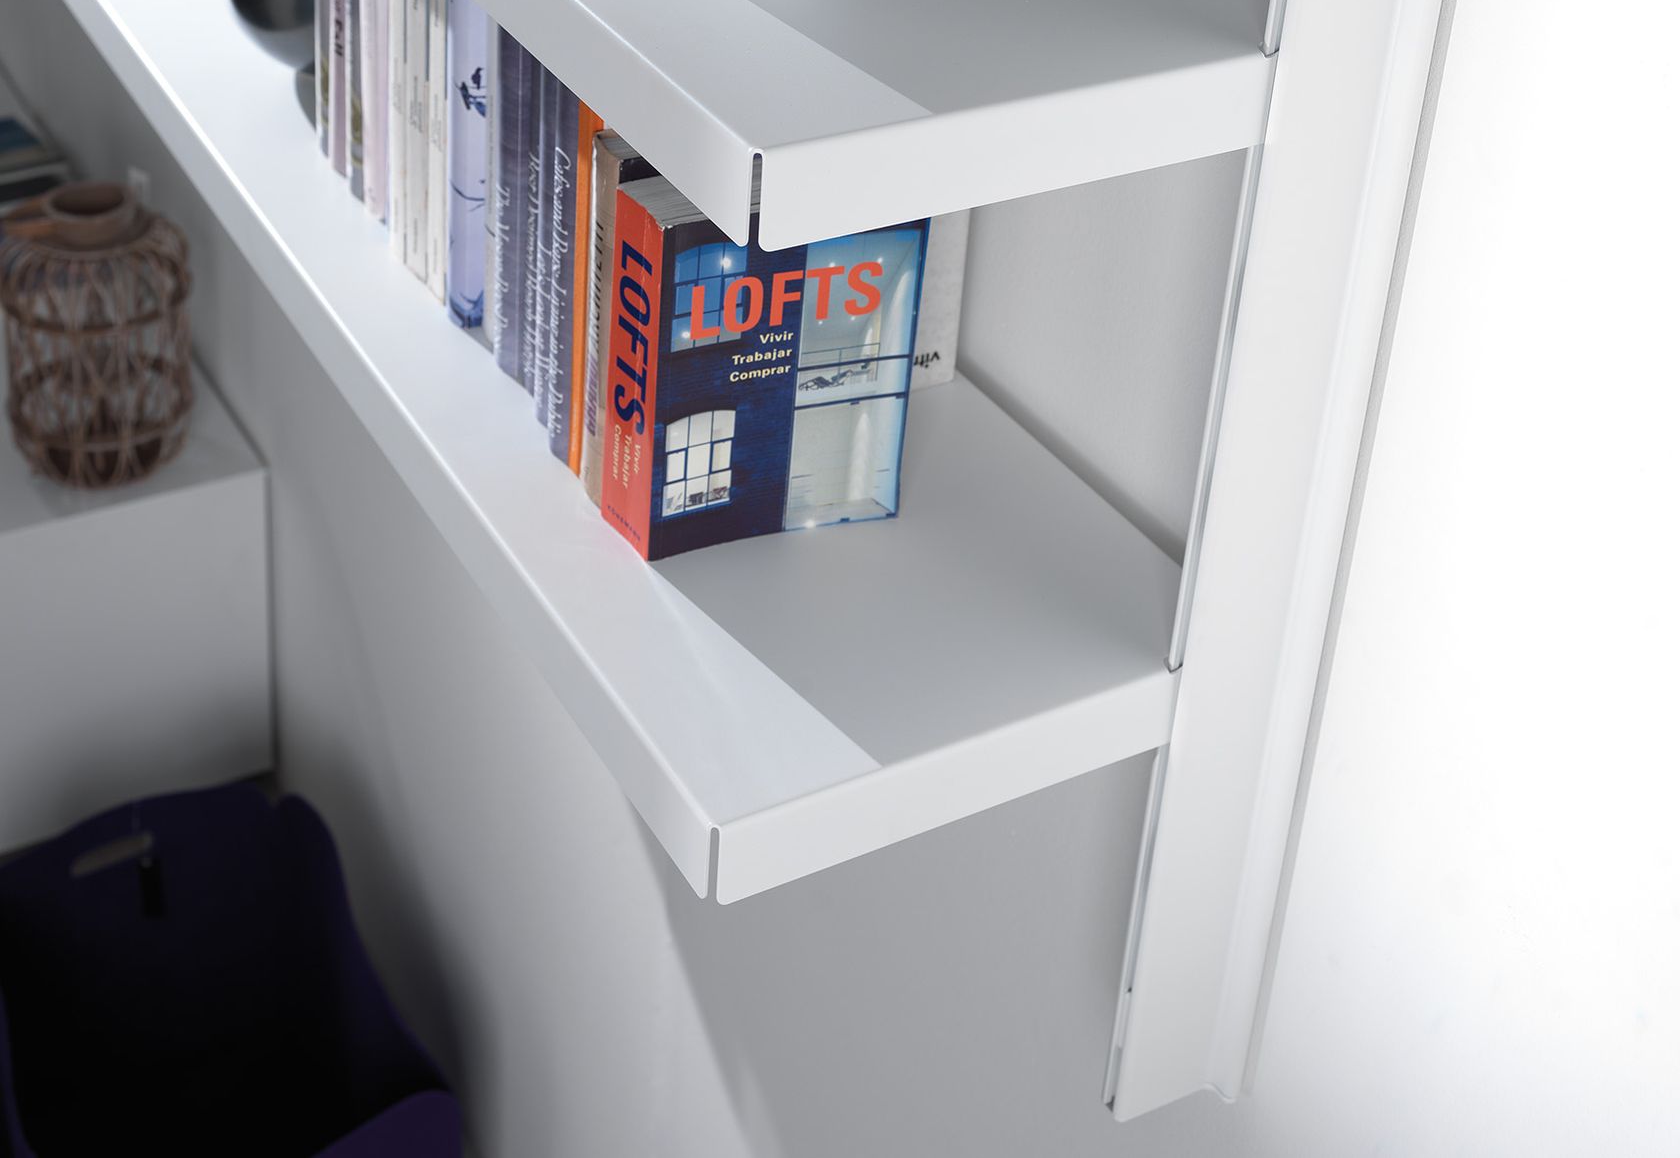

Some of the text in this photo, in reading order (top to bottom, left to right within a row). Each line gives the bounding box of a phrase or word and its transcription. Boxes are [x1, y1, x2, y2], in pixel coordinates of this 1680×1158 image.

[554, 146, 571, 197] Cafes
[552, 195, 569, 235] and
[690, 261, 883, 340] LOFTS
[614, 239, 653, 436] LOFTS
[732, 347, 793, 366] Trabajar
[759, 331, 794, 344] Vivir
[729, 365, 791, 383] Comprar
[612, 423, 622, 481] Comprar
[622, 433, 633, 489] Trabajar
[633, 443, 642, 475] Vivir
